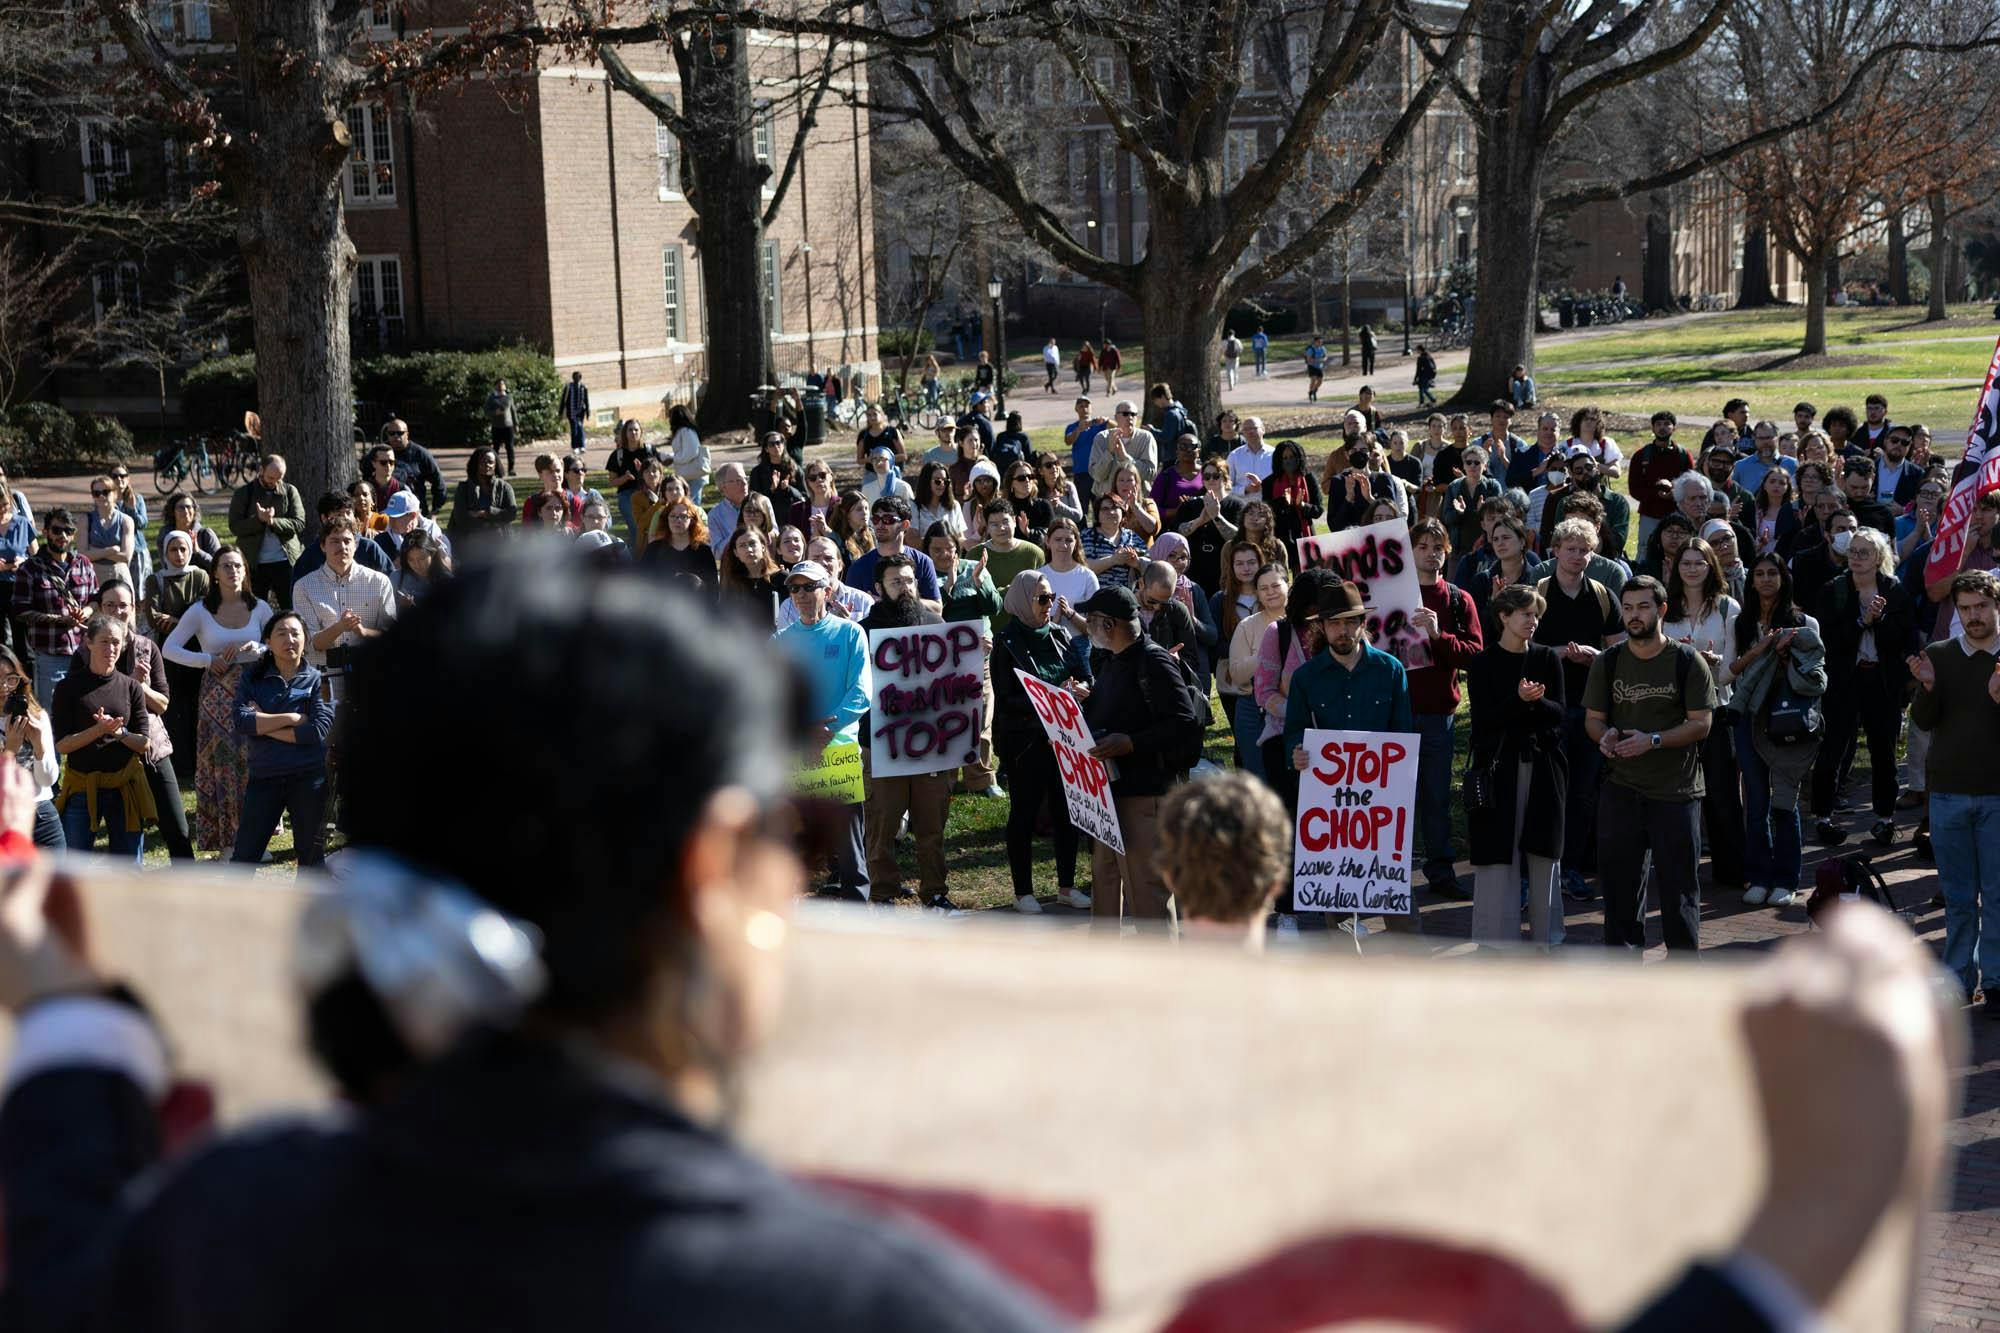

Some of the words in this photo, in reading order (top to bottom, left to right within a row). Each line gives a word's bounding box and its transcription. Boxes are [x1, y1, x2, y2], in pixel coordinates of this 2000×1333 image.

[875, 625, 979, 677] CHOP
[1023, 676, 1084, 739] STOP
[1613, 679, 1677, 704] Stagecoach
[875, 707, 980, 763] TOP!
[1058, 729, 1076, 747] the
[1053, 740, 1108, 808] CHOP
[1312, 742, 1406, 788] STOP
[1332, 787, 1373, 807] the
[1300, 806, 1406, 861] CHOP!
[1337, 856, 1366, 878] the
[1368, 855, 1408, 883] Area
[1298, 881, 1360, 909] Studies
[1363, 880, 1411, 911] Centers
